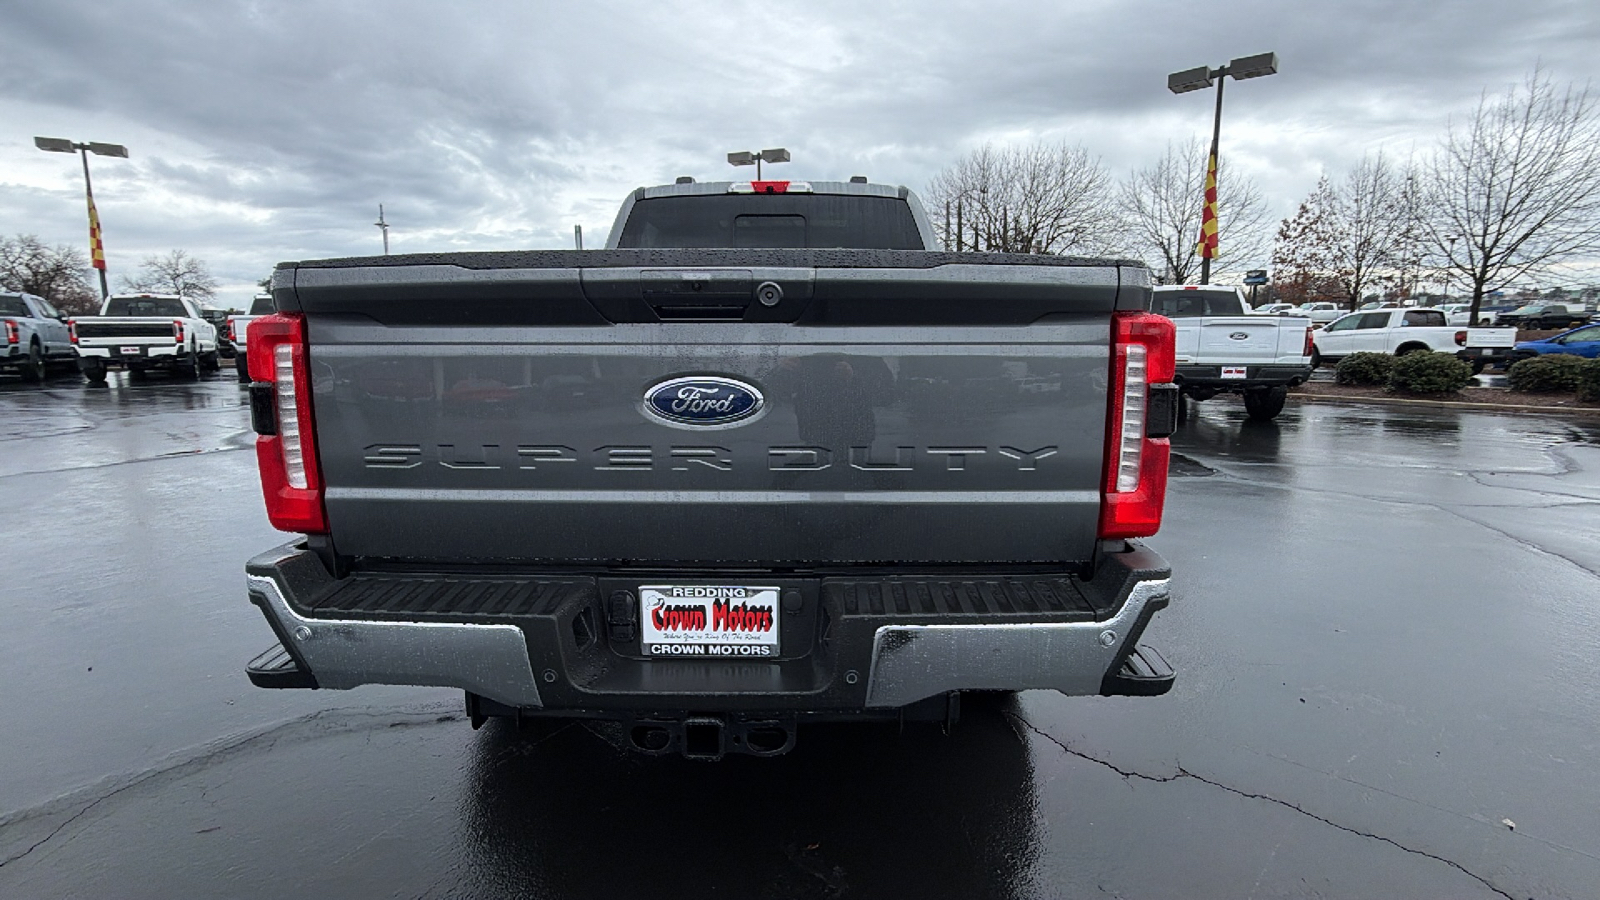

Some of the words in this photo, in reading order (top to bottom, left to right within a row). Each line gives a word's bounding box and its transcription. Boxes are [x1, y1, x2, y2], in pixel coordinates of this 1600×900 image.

[671, 386, 735, 414] Ford
[363, 444, 732, 471] SUPER
[768, 446, 1059, 471] DUTY
[673, 587, 746, 598] REDDING
[651, 598, 707, 632] Crown
[712, 598, 773, 632] Motors
[721, 633, 730, 641] Of
[651, 644, 706, 655] CROWN
[708, 645, 771, 655] MOTORS
